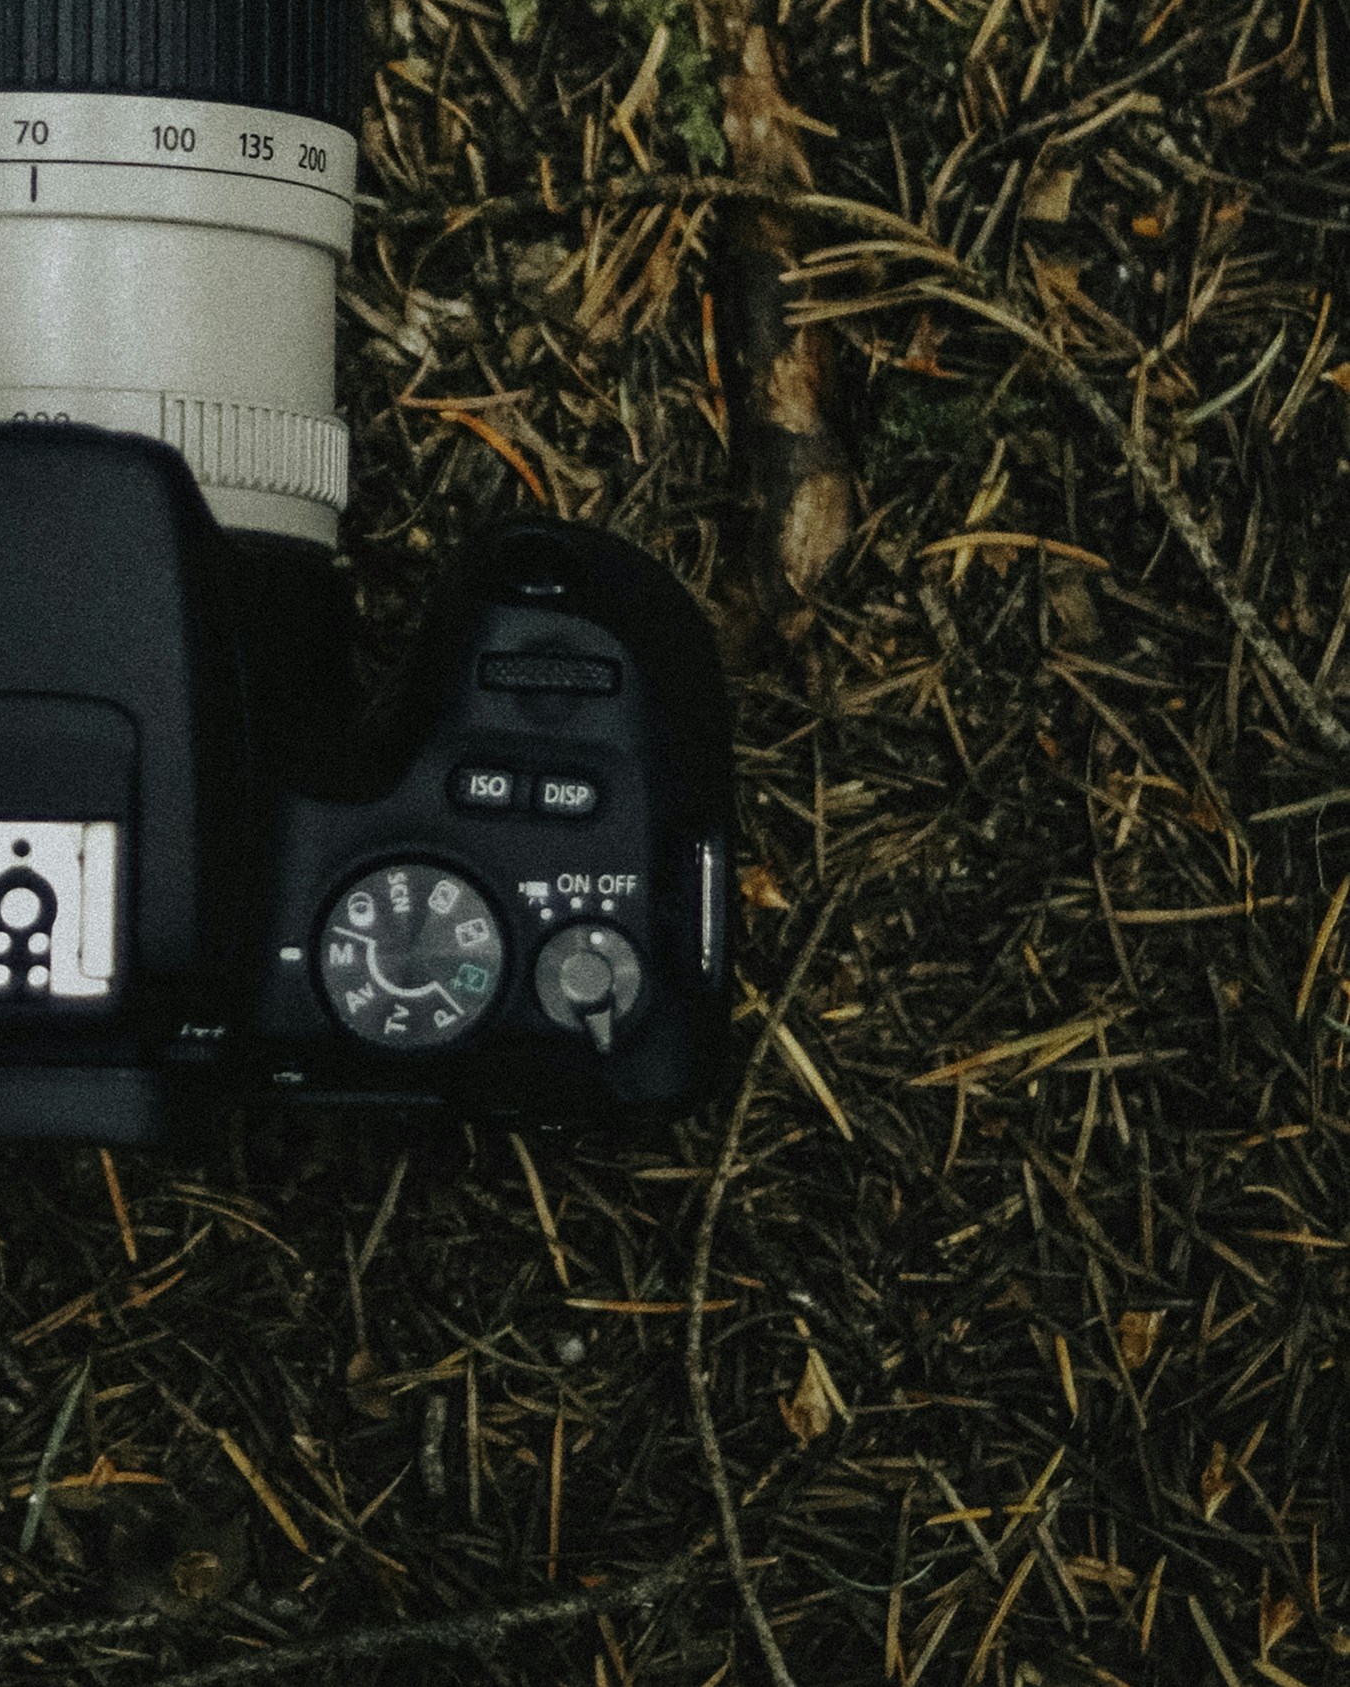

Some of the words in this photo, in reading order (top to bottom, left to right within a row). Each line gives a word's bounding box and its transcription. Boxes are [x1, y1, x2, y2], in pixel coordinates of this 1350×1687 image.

[13, 120, 50, 145] 70
[152, 125, 196, 153] 100
[239, 133, 275, 161] 135
[298, 144, 327, 173] 200
[470, 775, 507, 797] ISO
[544, 783, 590, 806] DISP
[557, 873, 590, 894] ON
[598, 874, 638, 895] OFF
[329, 942, 354, 964] M
[345, 981, 375, 1014] Av
[383, 1003, 410, 1035] Tv
[433, 1009, 458, 1029] P
